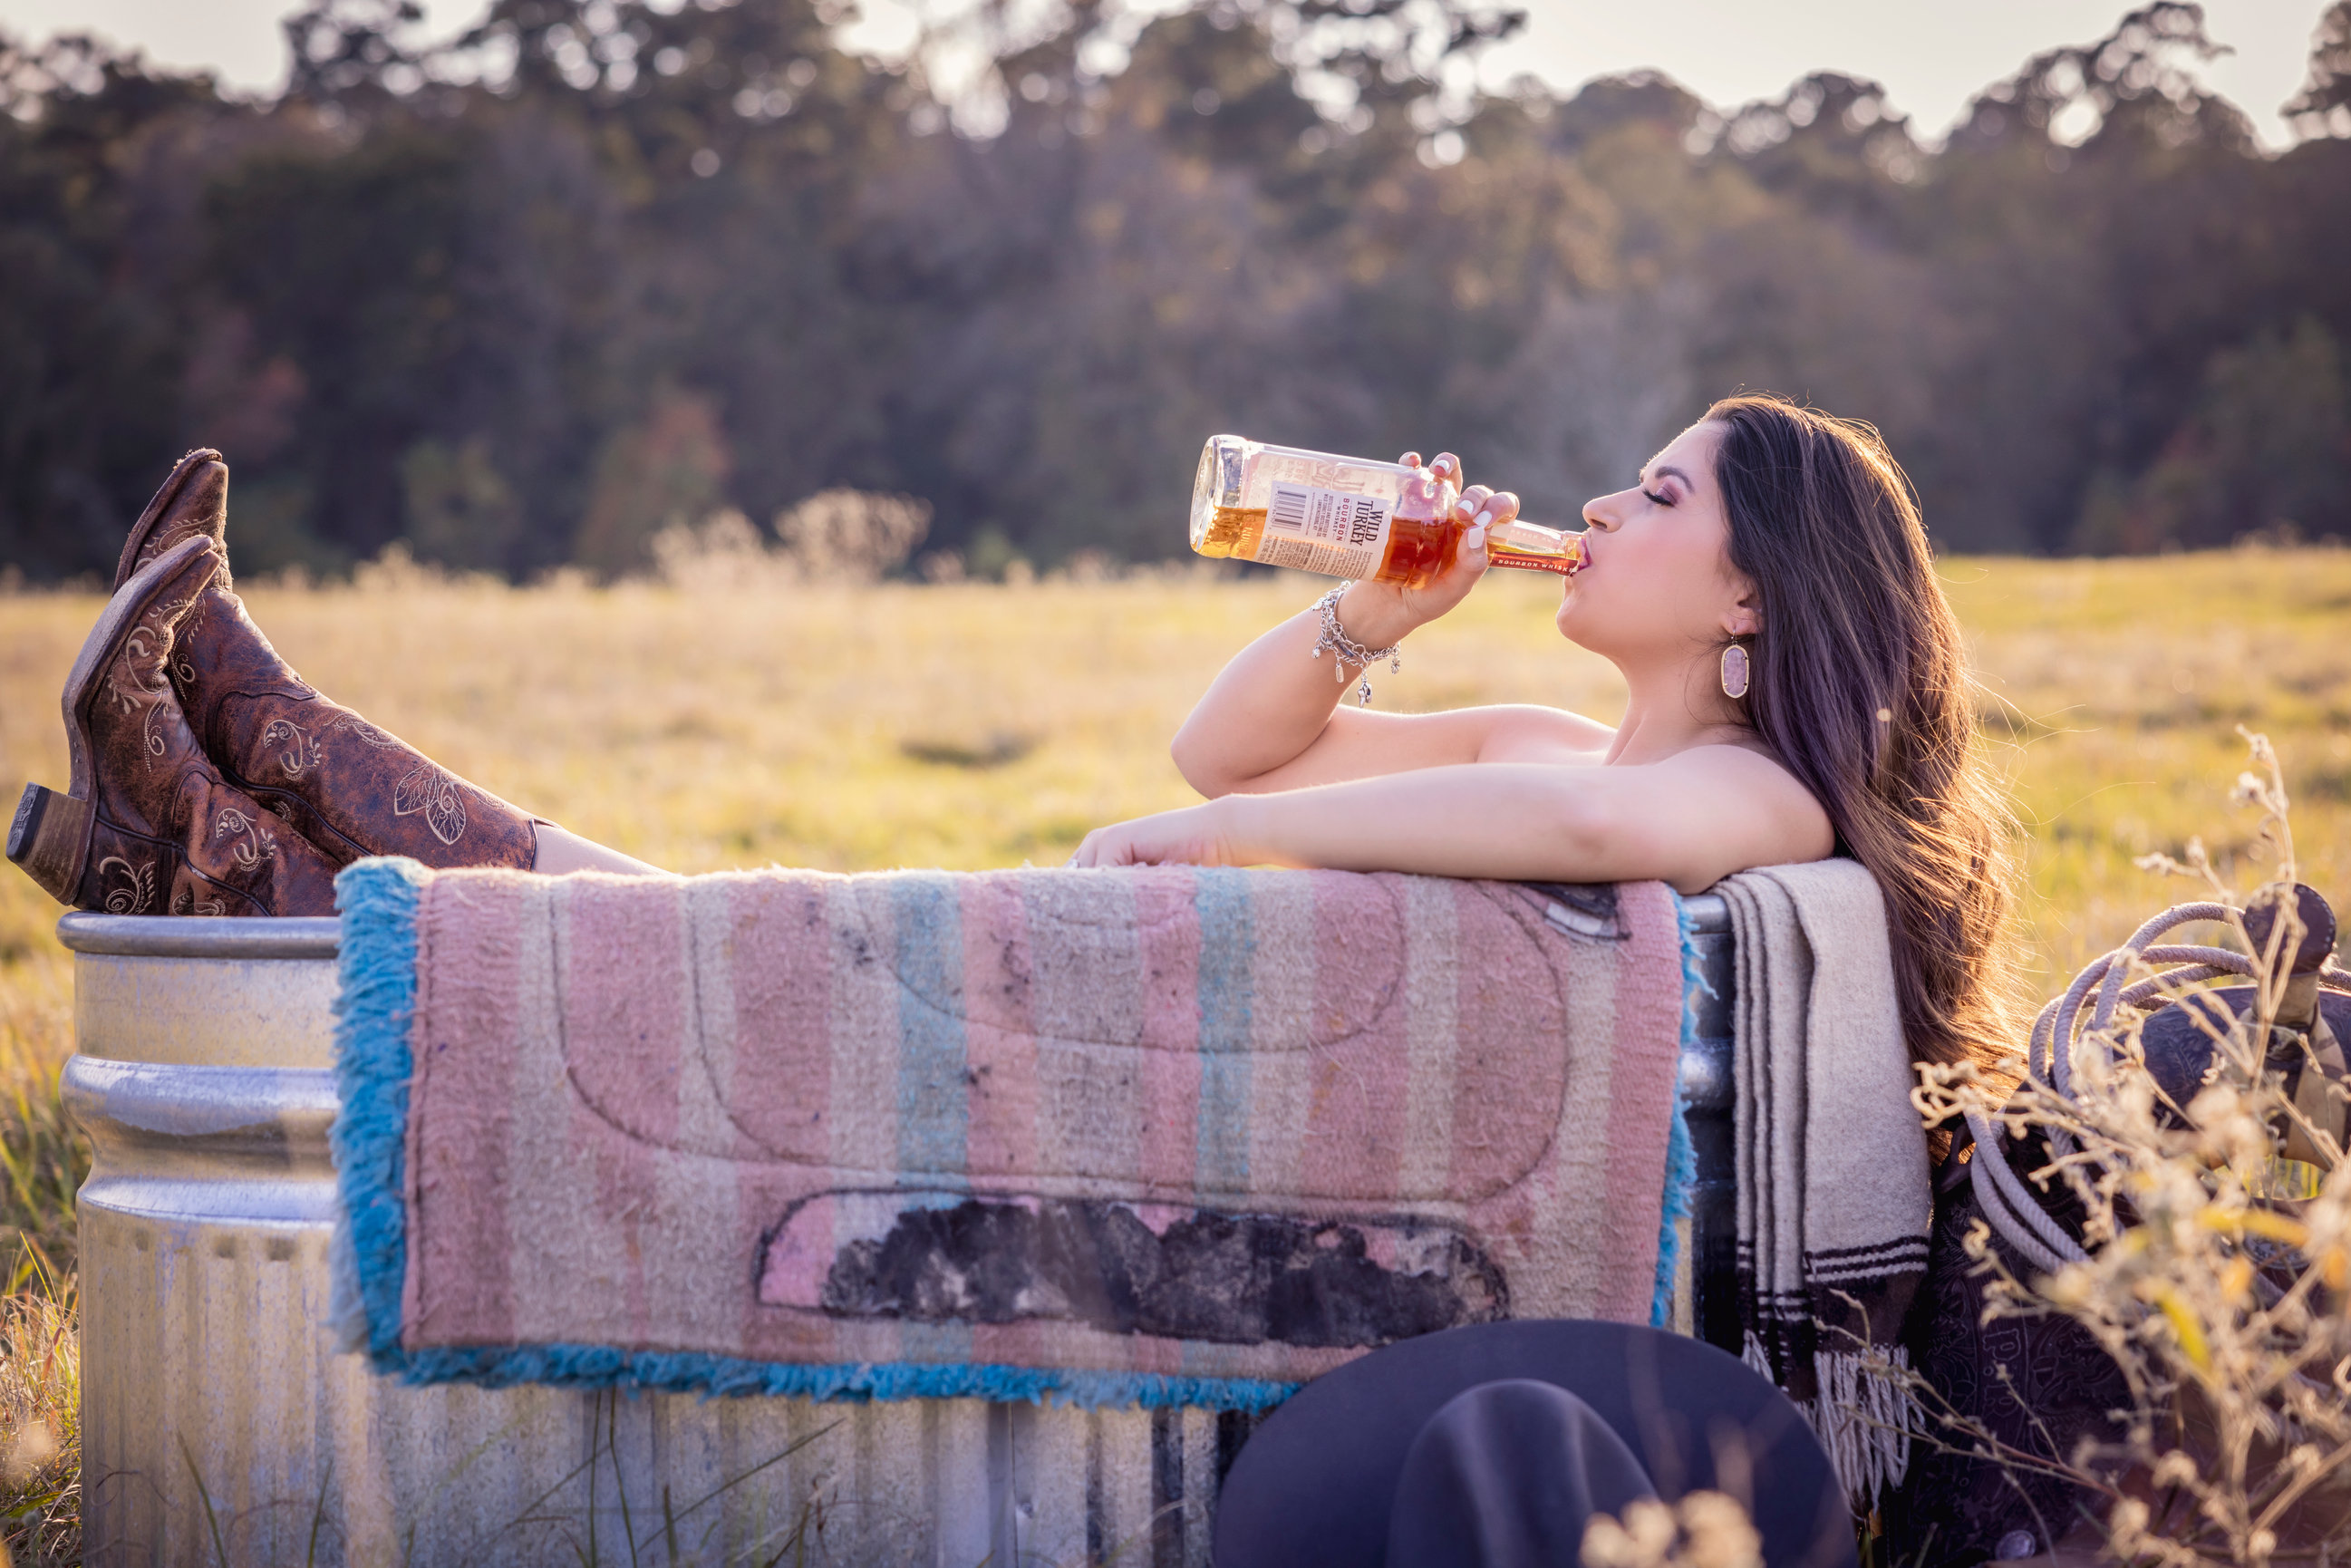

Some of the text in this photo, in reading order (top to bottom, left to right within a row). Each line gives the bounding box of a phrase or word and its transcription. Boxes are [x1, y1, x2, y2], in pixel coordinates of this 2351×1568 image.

[1332, 506, 1340, 532] WHISKEY
[1336, 498, 1350, 541] BOURBON
[1350, 500, 1373, 546] TURKEY
[1365, 510, 1383, 541] WILD
